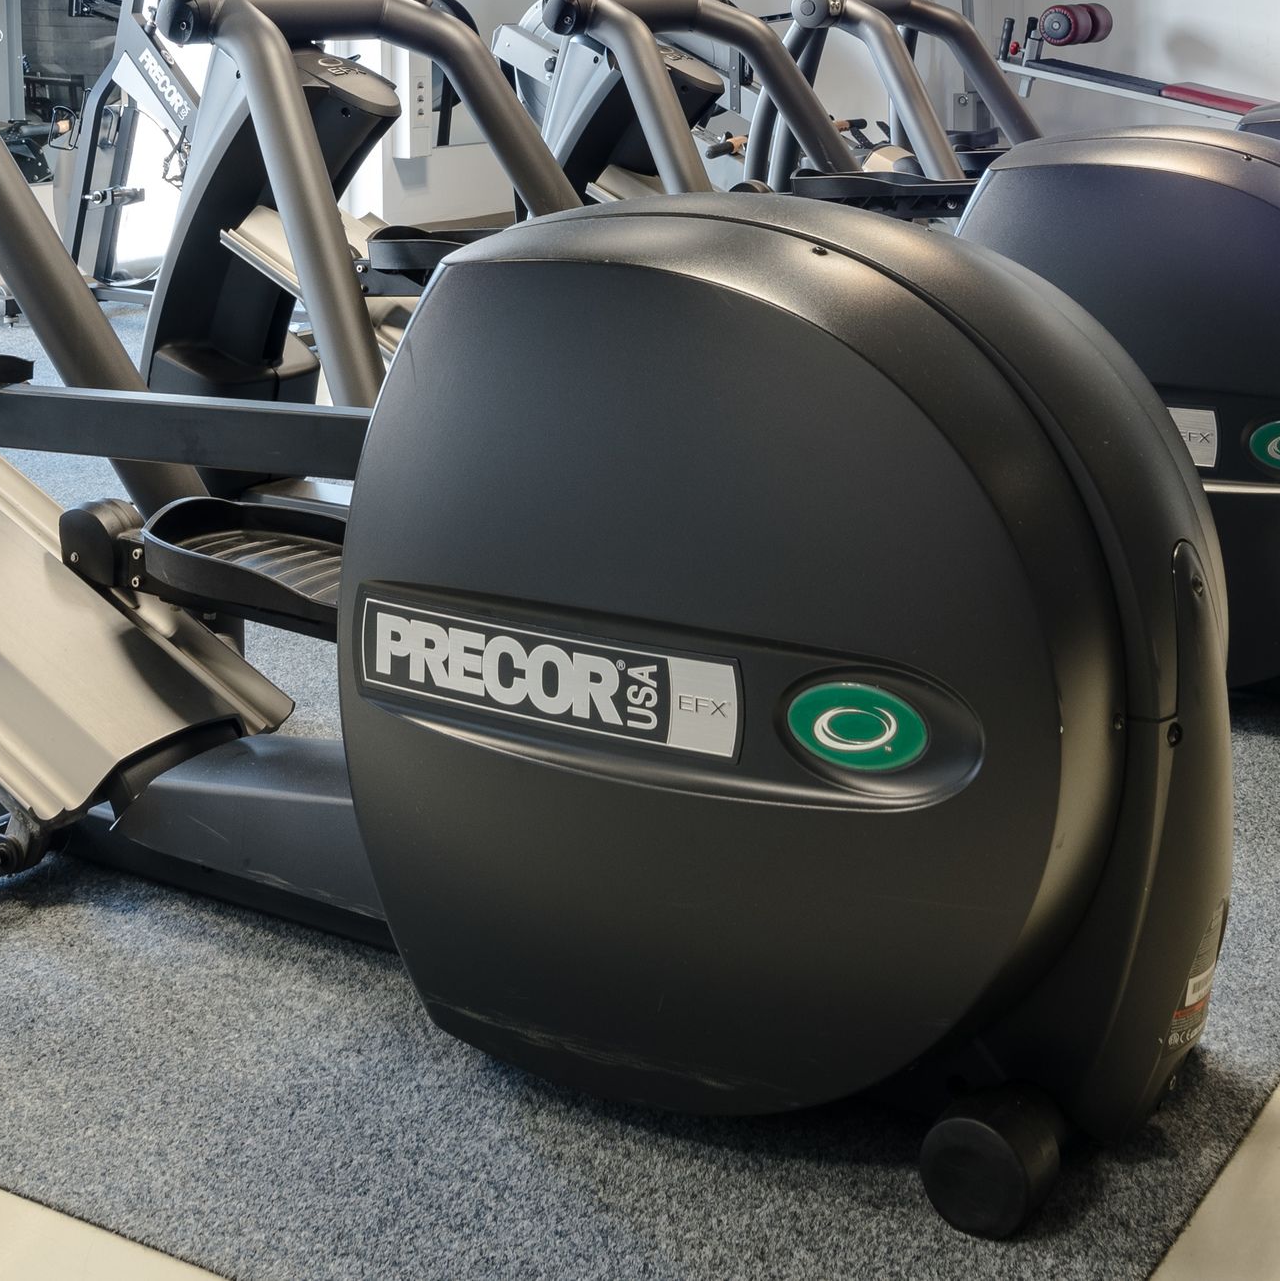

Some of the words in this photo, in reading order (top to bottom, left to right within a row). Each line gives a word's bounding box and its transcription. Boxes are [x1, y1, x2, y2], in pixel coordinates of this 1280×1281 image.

[138, 47, 184, 114] PRECOR
[375, 612, 624, 726] PRECOR
[626, 664, 658, 731] USA
[678, 694, 728, 719] EFX
